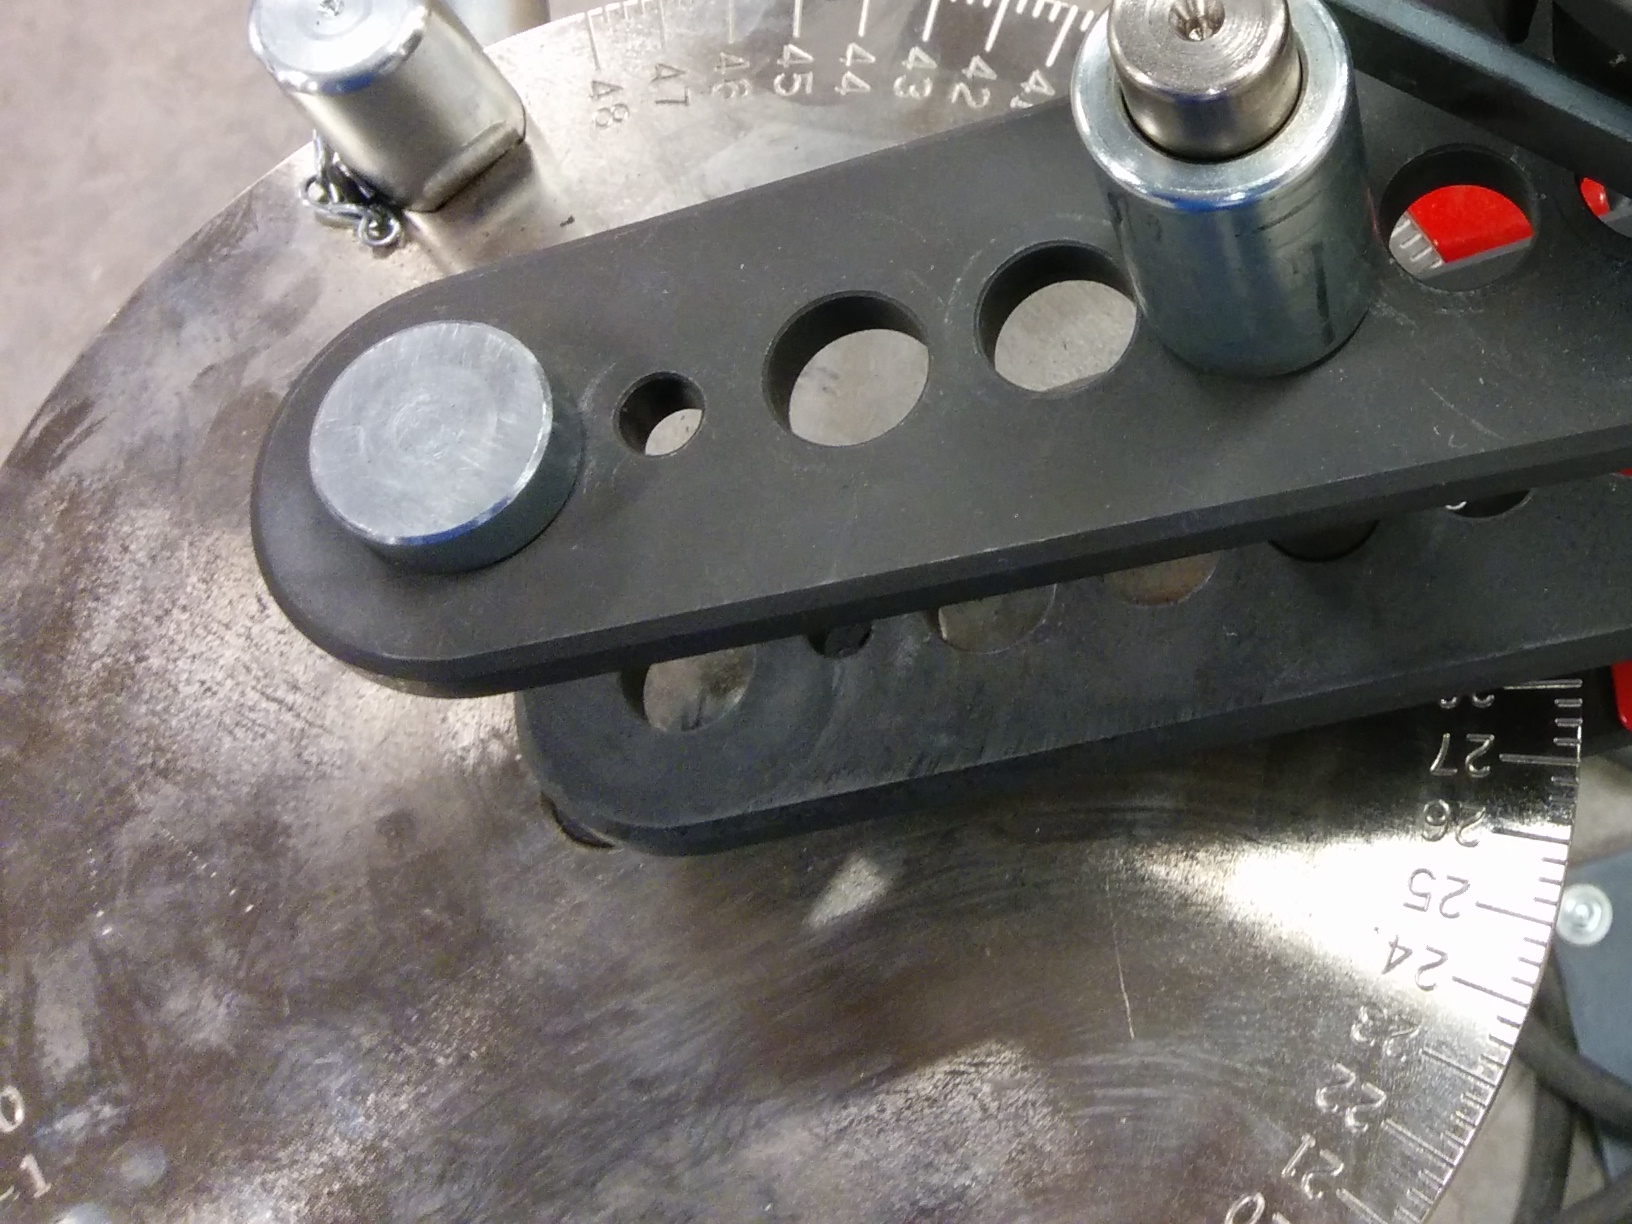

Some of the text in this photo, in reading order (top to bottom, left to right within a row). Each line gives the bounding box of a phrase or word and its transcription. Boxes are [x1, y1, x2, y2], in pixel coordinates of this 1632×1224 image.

[650, 62, 691, 107] 47
[711, 51, 751, 101] 46
[774, 42, 815, 97] 45
[833, 42, 877, 97] 44
[893, 45, 938, 101] 43
[950, 54, 998, 109] 42
[588, 79, 630, 129] 48
[1429, 732, 1495, 777] 27
[1421, 797, 1486, 848] 26
[1403, 867, 1470, 919] 25
[1381, 934, 1449, 992] 24
[1350, 1002, 1421, 1062] 23
[1314, 1061, 1387, 1134] 22
[20, 1154, 51, 1198] 1
[1281, 1132, 1345, 1200] 21
